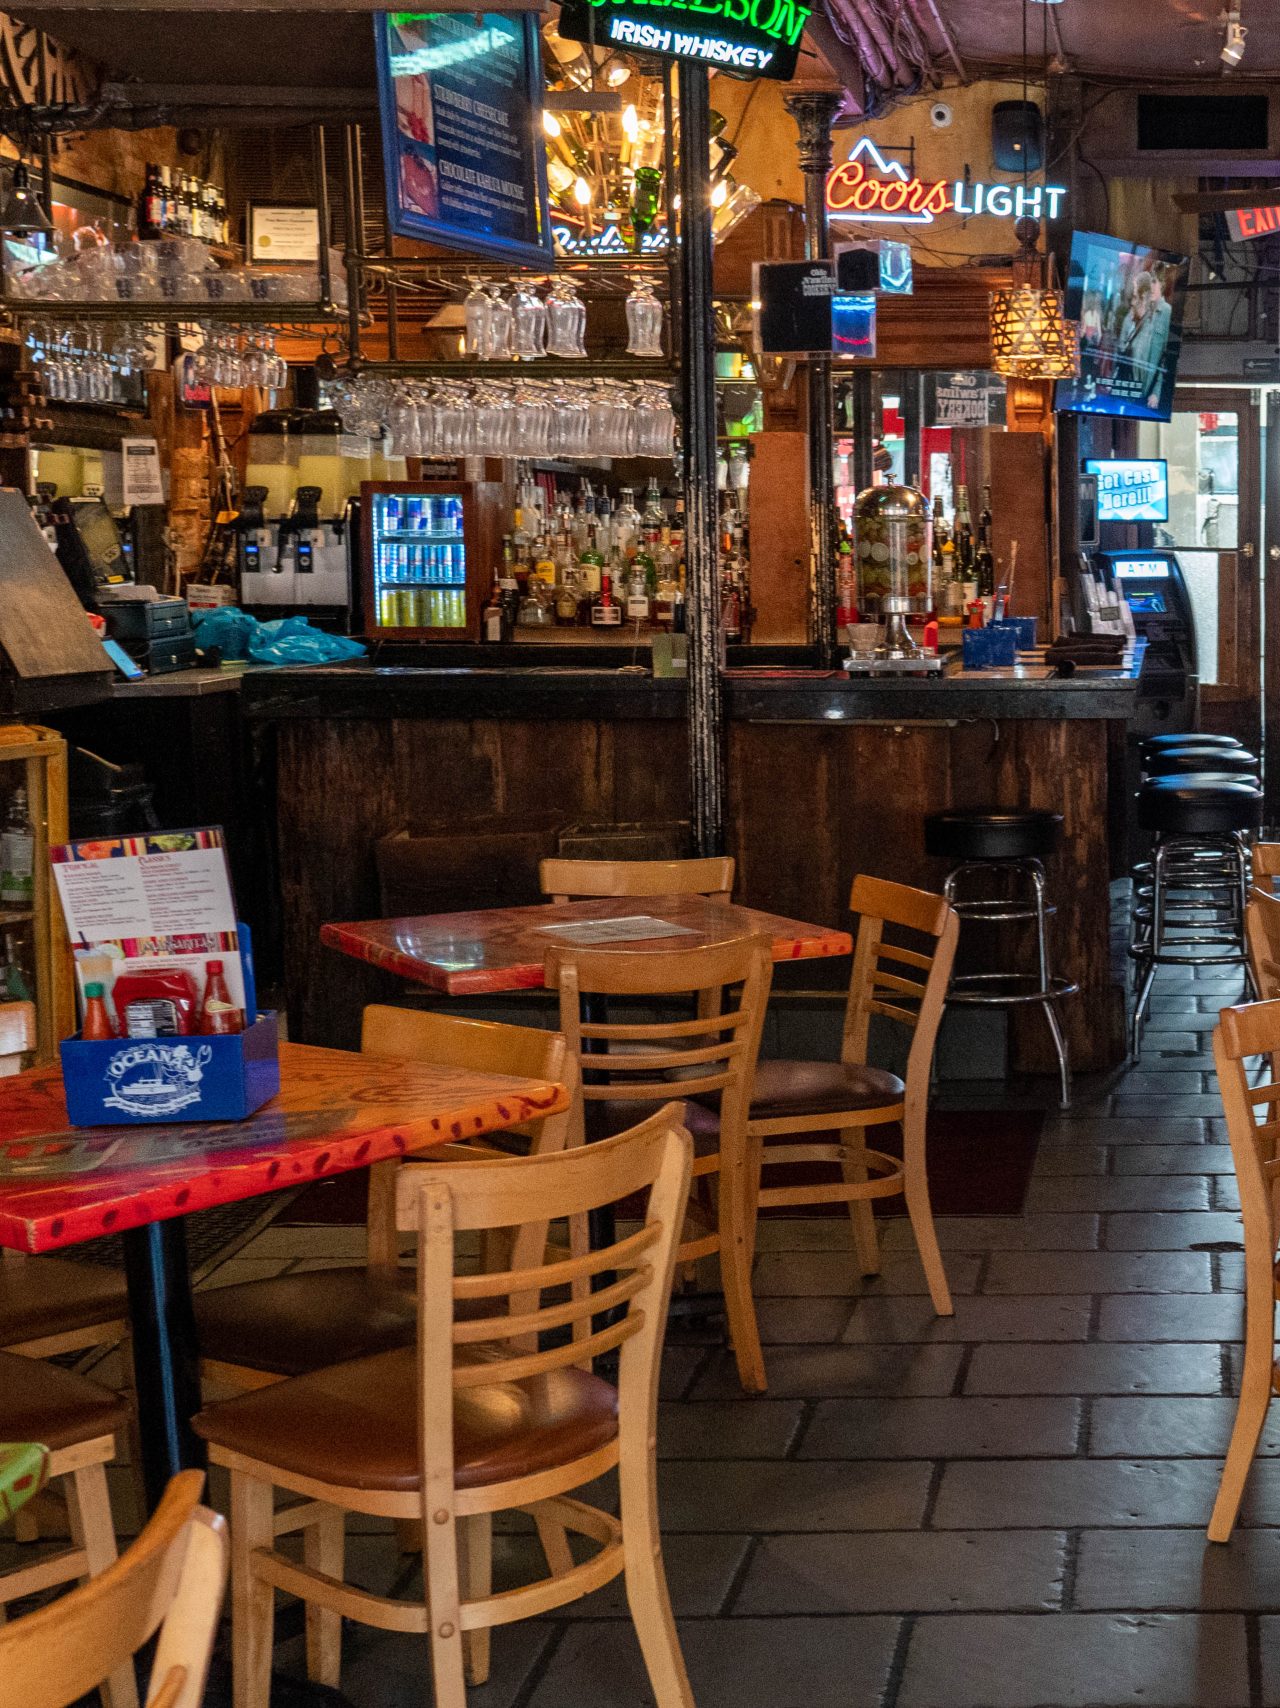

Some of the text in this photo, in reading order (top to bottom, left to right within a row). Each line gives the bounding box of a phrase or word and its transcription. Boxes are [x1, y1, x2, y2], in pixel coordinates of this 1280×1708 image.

[610, 19, 671, 51] IRISH
[674, 34, 773, 69] WHISKEY
[827, 161, 1067, 219] Coors LIGHT
[111, 1047, 187, 1078] OCEANA
